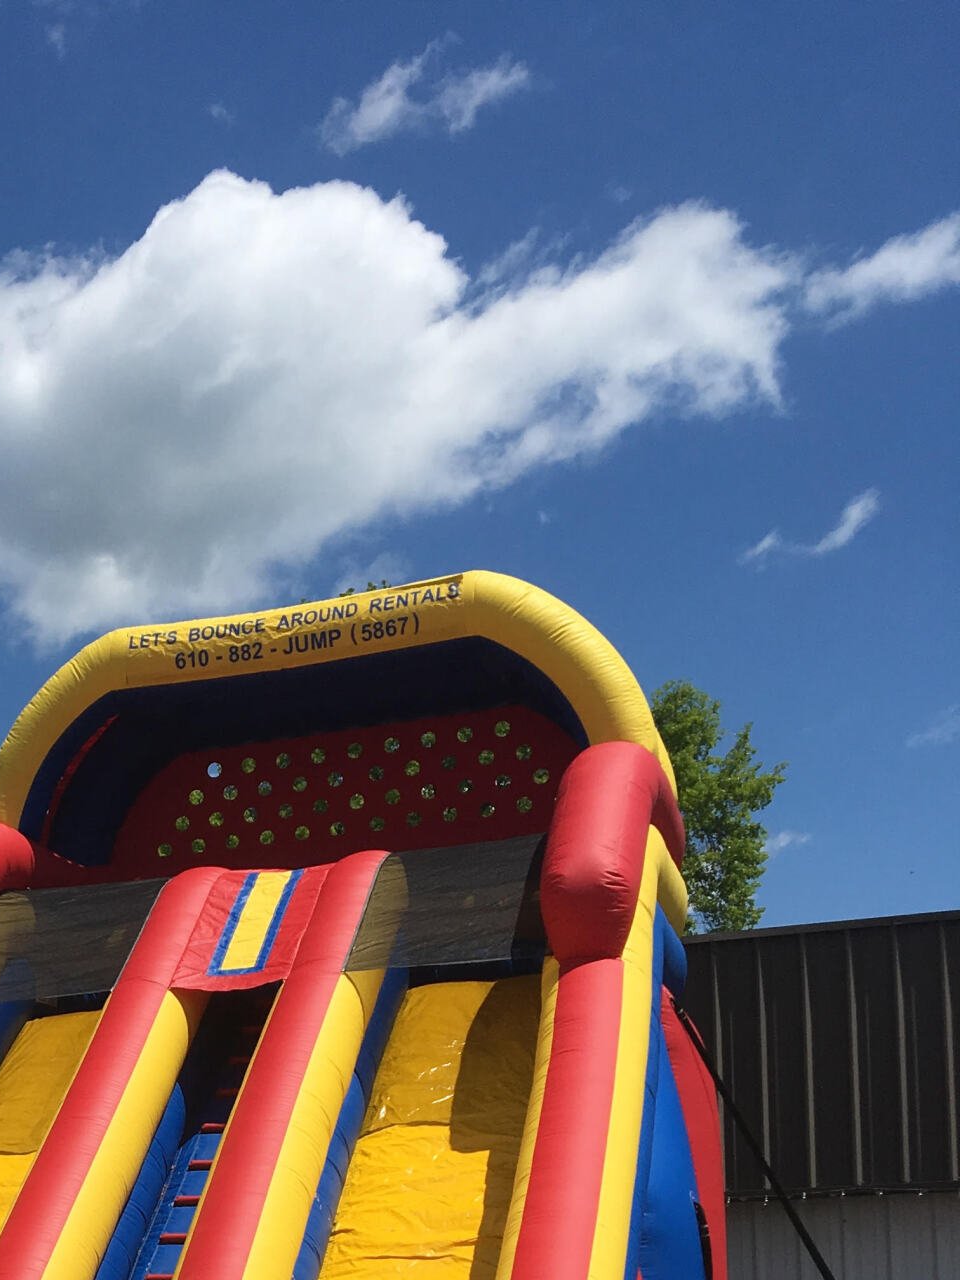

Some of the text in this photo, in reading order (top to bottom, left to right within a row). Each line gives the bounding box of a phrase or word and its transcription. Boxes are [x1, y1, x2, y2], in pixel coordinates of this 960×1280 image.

[129, 582, 461, 649] LET'S BOUNCE AROUND RENTALS
[175, 649, 209, 669] 610
[229, 643, 263, 663] 882
[283, 629, 342, 655] JUMP
